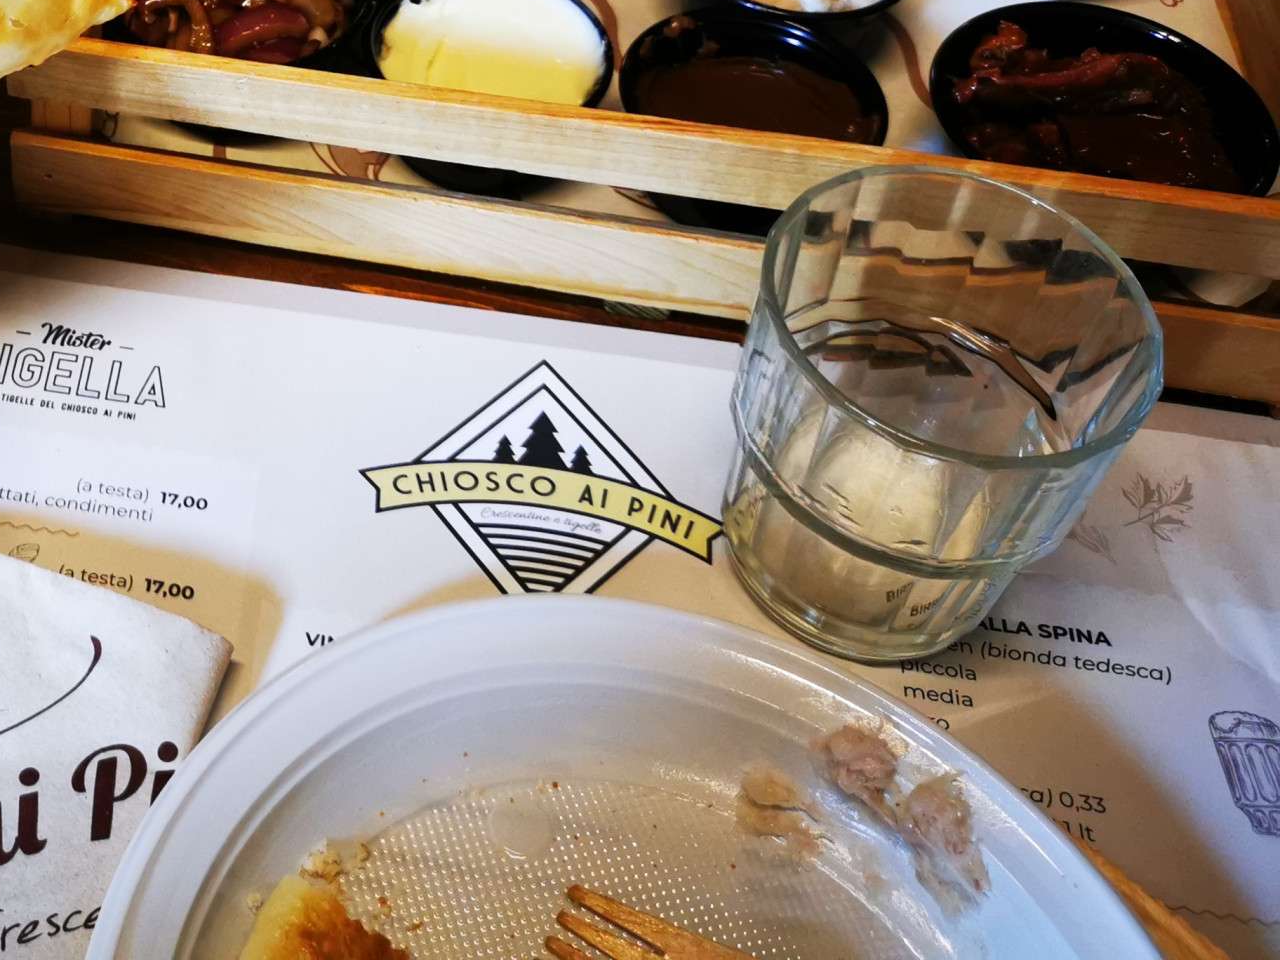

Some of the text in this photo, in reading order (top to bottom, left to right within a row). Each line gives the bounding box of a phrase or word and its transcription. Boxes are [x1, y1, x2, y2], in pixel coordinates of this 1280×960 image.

[41, 322, 112, 351] Mister
[1, 393, 34, 407] TIGELLE
[40, 399, 55, 409] DEL
[61, 402, 99, 416] CHIOSCO
[103, 408, 113, 417] AI
[117, 410, 137, 421] PINI
[44, 494, 154, 523] condimenti
[76, 478, 209, 511] (a testa) 17,00
[391, 469, 697, 541] CHIOSCO AI PINI
[80, 568, 134, 592] testa)
[143, 577, 195, 601] 17,00
[1038, 623, 1113, 647] SPINA
[899, 658, 977, 681] piccola
[980, 640, 1067, 668] (bionda
[1074, 655, 1173, 685] tedesca)
[902, 684, 974, 707] media
[1059, 791, 1106, 814] 0,33
